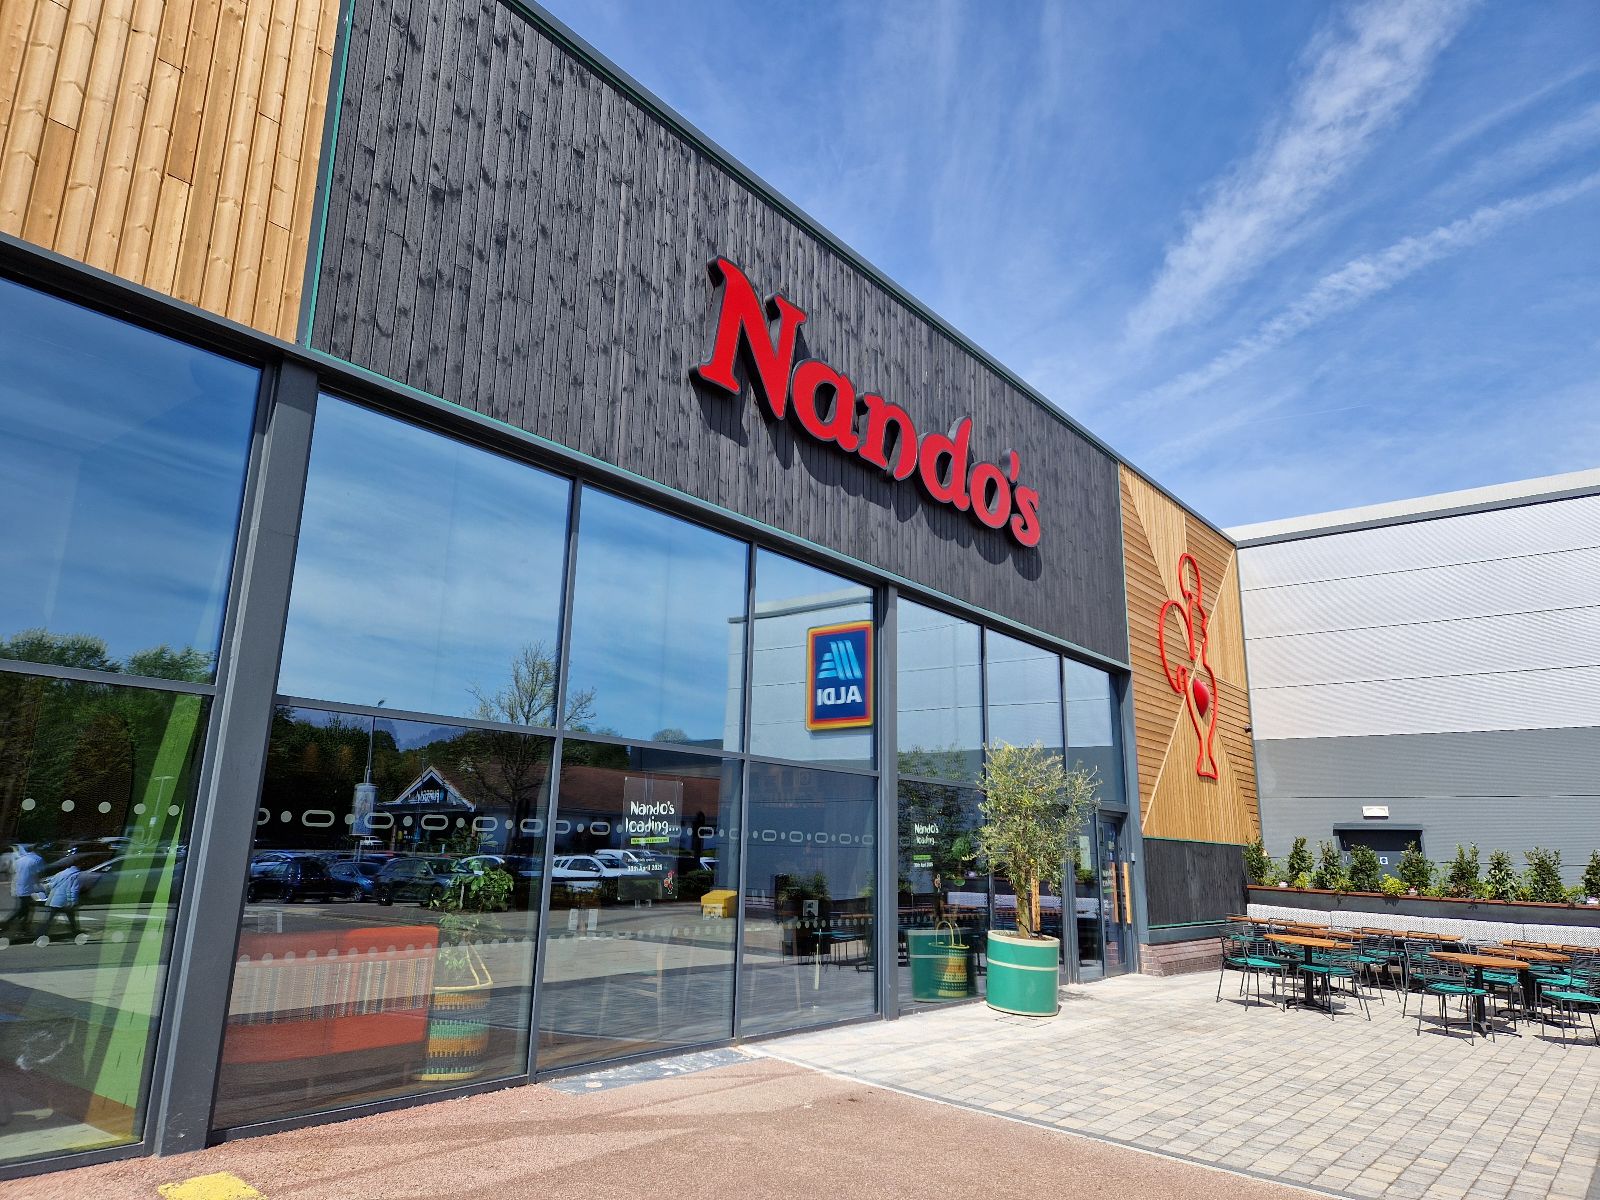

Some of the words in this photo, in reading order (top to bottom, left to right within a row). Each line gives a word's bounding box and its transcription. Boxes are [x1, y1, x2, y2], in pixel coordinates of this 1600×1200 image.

[690, 255, 1041, 548] Nando's
[630, 801, 675, 815] Nando's
[914, 823, 939, 834] Nando's
